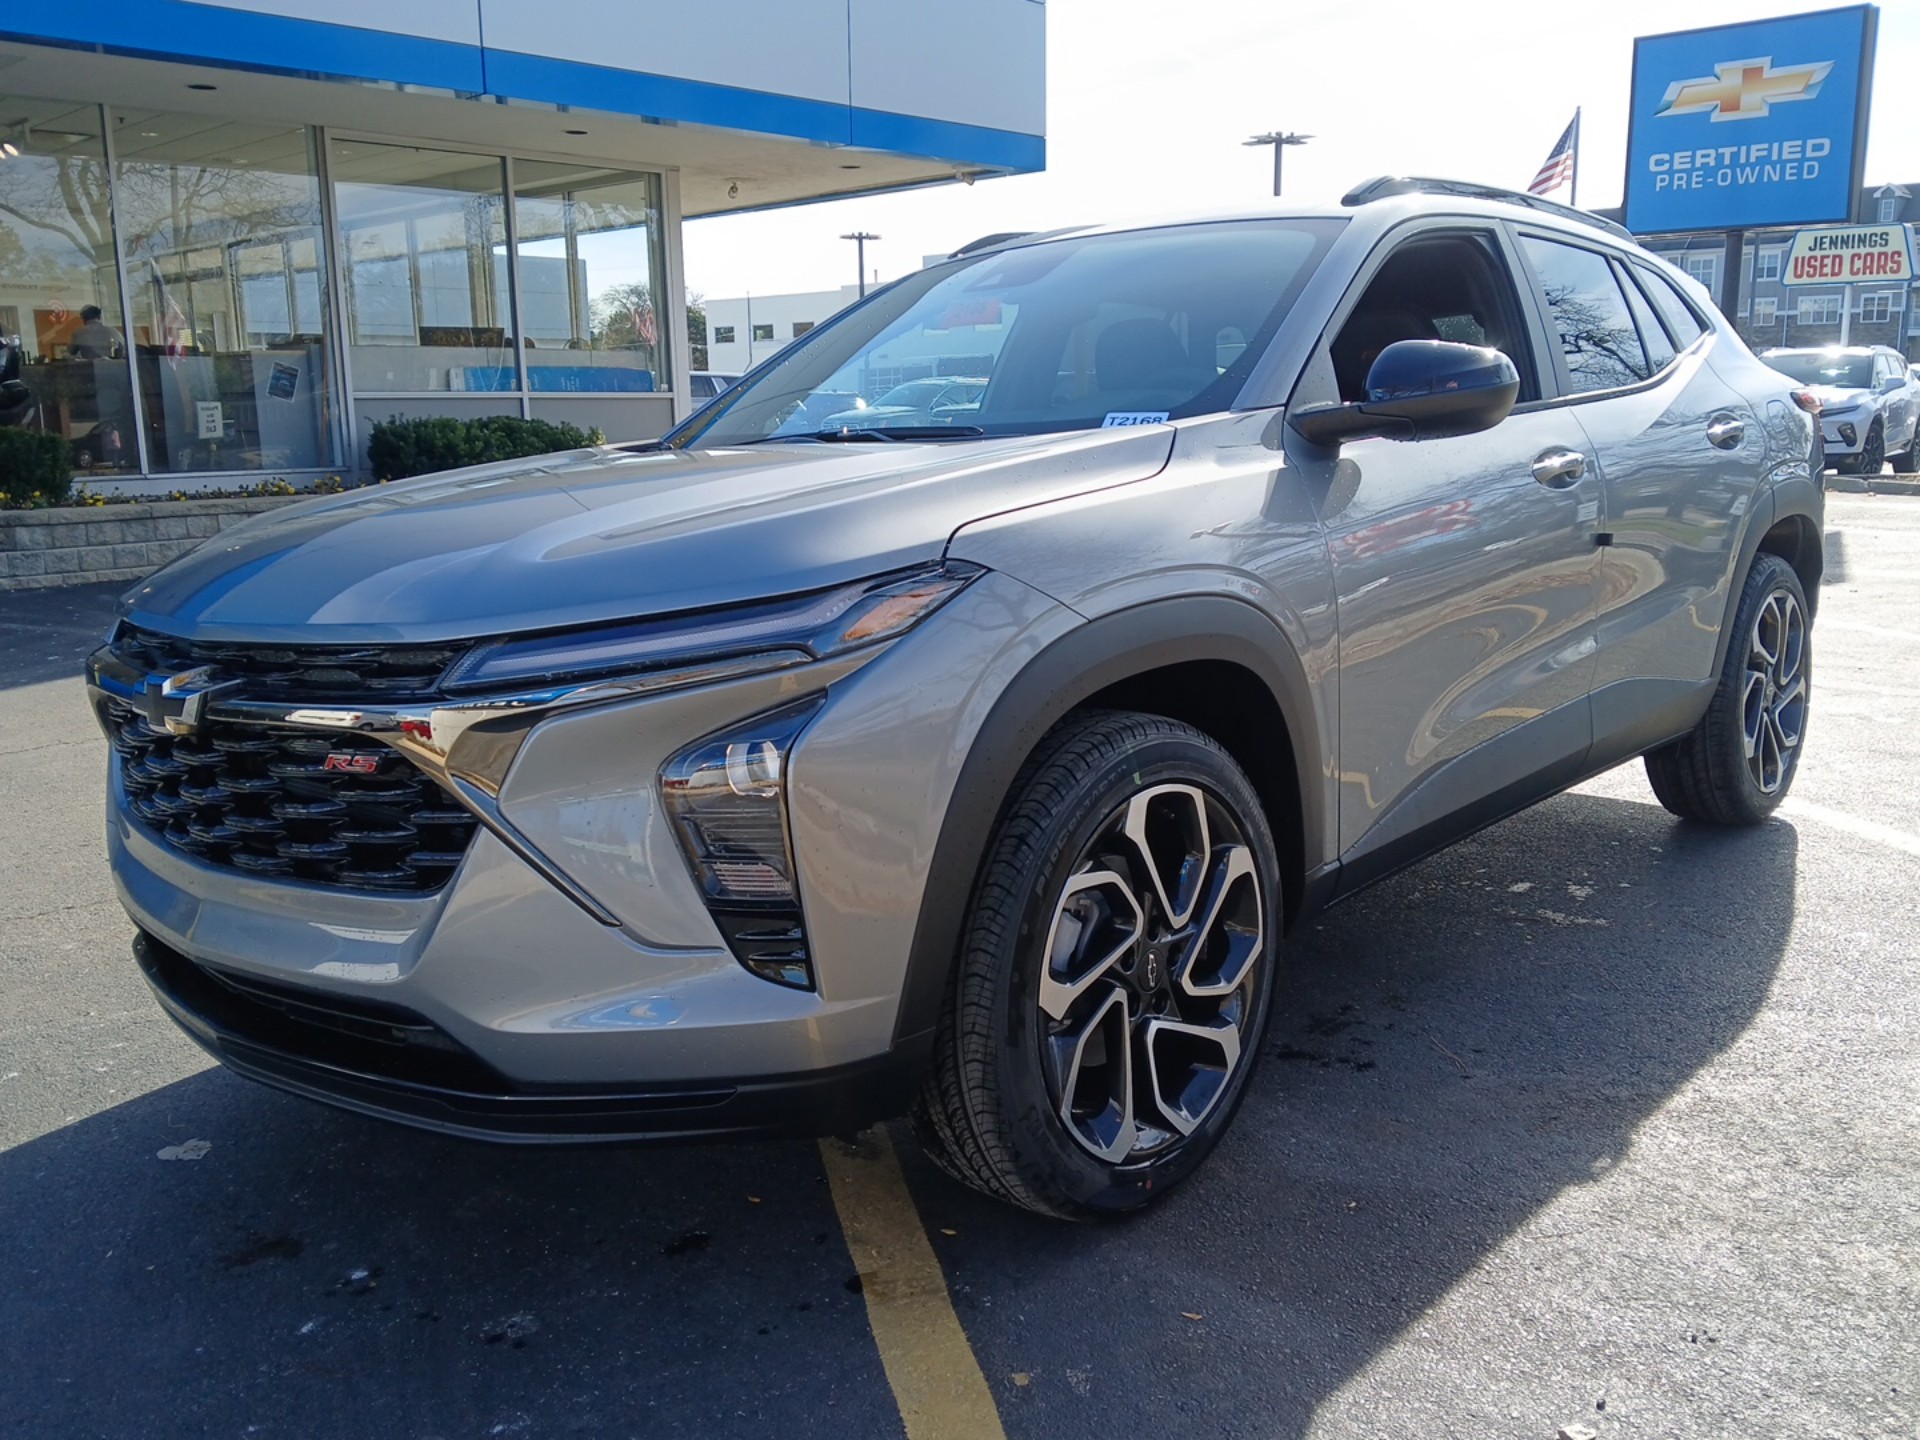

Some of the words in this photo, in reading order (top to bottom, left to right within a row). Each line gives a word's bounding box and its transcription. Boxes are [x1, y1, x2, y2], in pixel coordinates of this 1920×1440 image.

[1648, 137, 1831, 172] CERTIFIED
[1655, 160, 1819, 192] PRE-OWNED
[1808, 232, 1889, 252] JENNINGS
[1793, 254, 1843, 279] USED
[1849, 250, 1902, 276] CARS
[324, 754, 379, 772] RS
